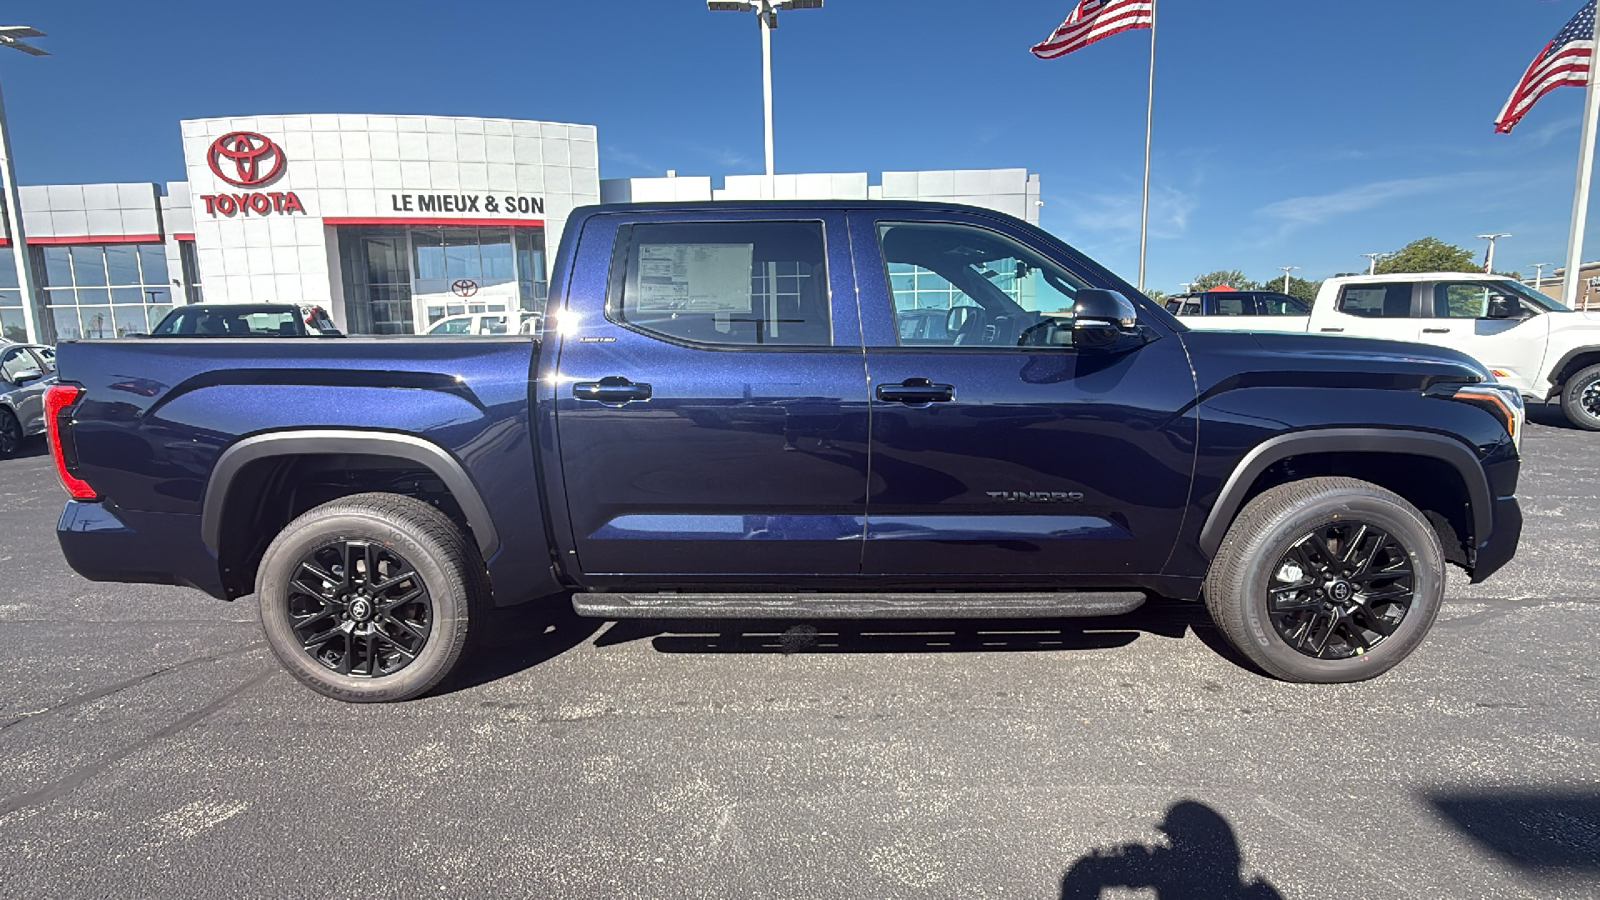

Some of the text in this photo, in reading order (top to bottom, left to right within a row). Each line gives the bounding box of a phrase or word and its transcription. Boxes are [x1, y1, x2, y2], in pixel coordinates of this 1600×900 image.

[200, 192, 301, 214] TOYOTA
[392, 194, 545, 214] LE MIEUX & SON
[986, 491, 1084, 503] TUNDRA
